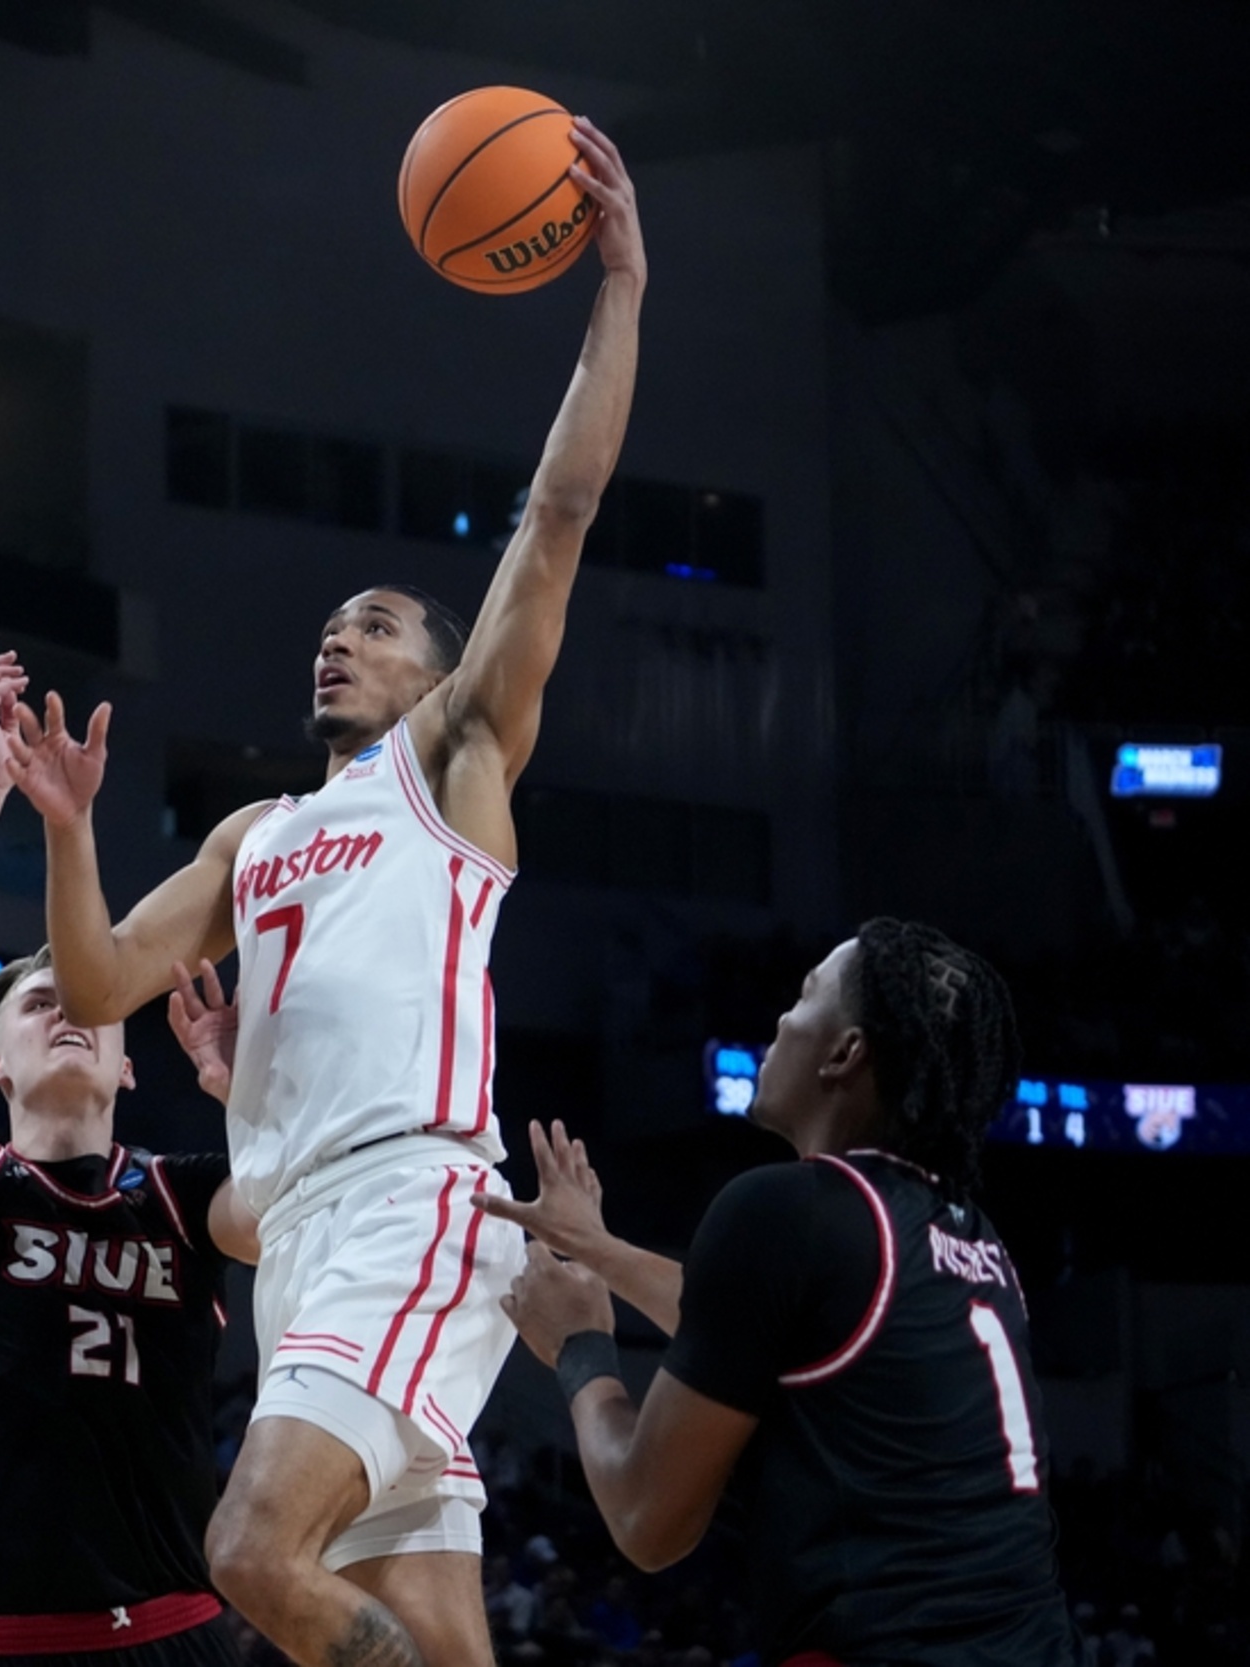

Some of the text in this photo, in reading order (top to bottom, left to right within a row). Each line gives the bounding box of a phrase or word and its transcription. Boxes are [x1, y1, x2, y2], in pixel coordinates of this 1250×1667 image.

[485, 192, 594, 274] Wilso
[254, 902, 305, 1017] 7
[1123, 1083, 1196, 1118] SIUE
[4, 1221, 181, 1305] SIUE
[68, 1304, 140, 1386] 21
[968, 1298, 1040, 1494] 1
